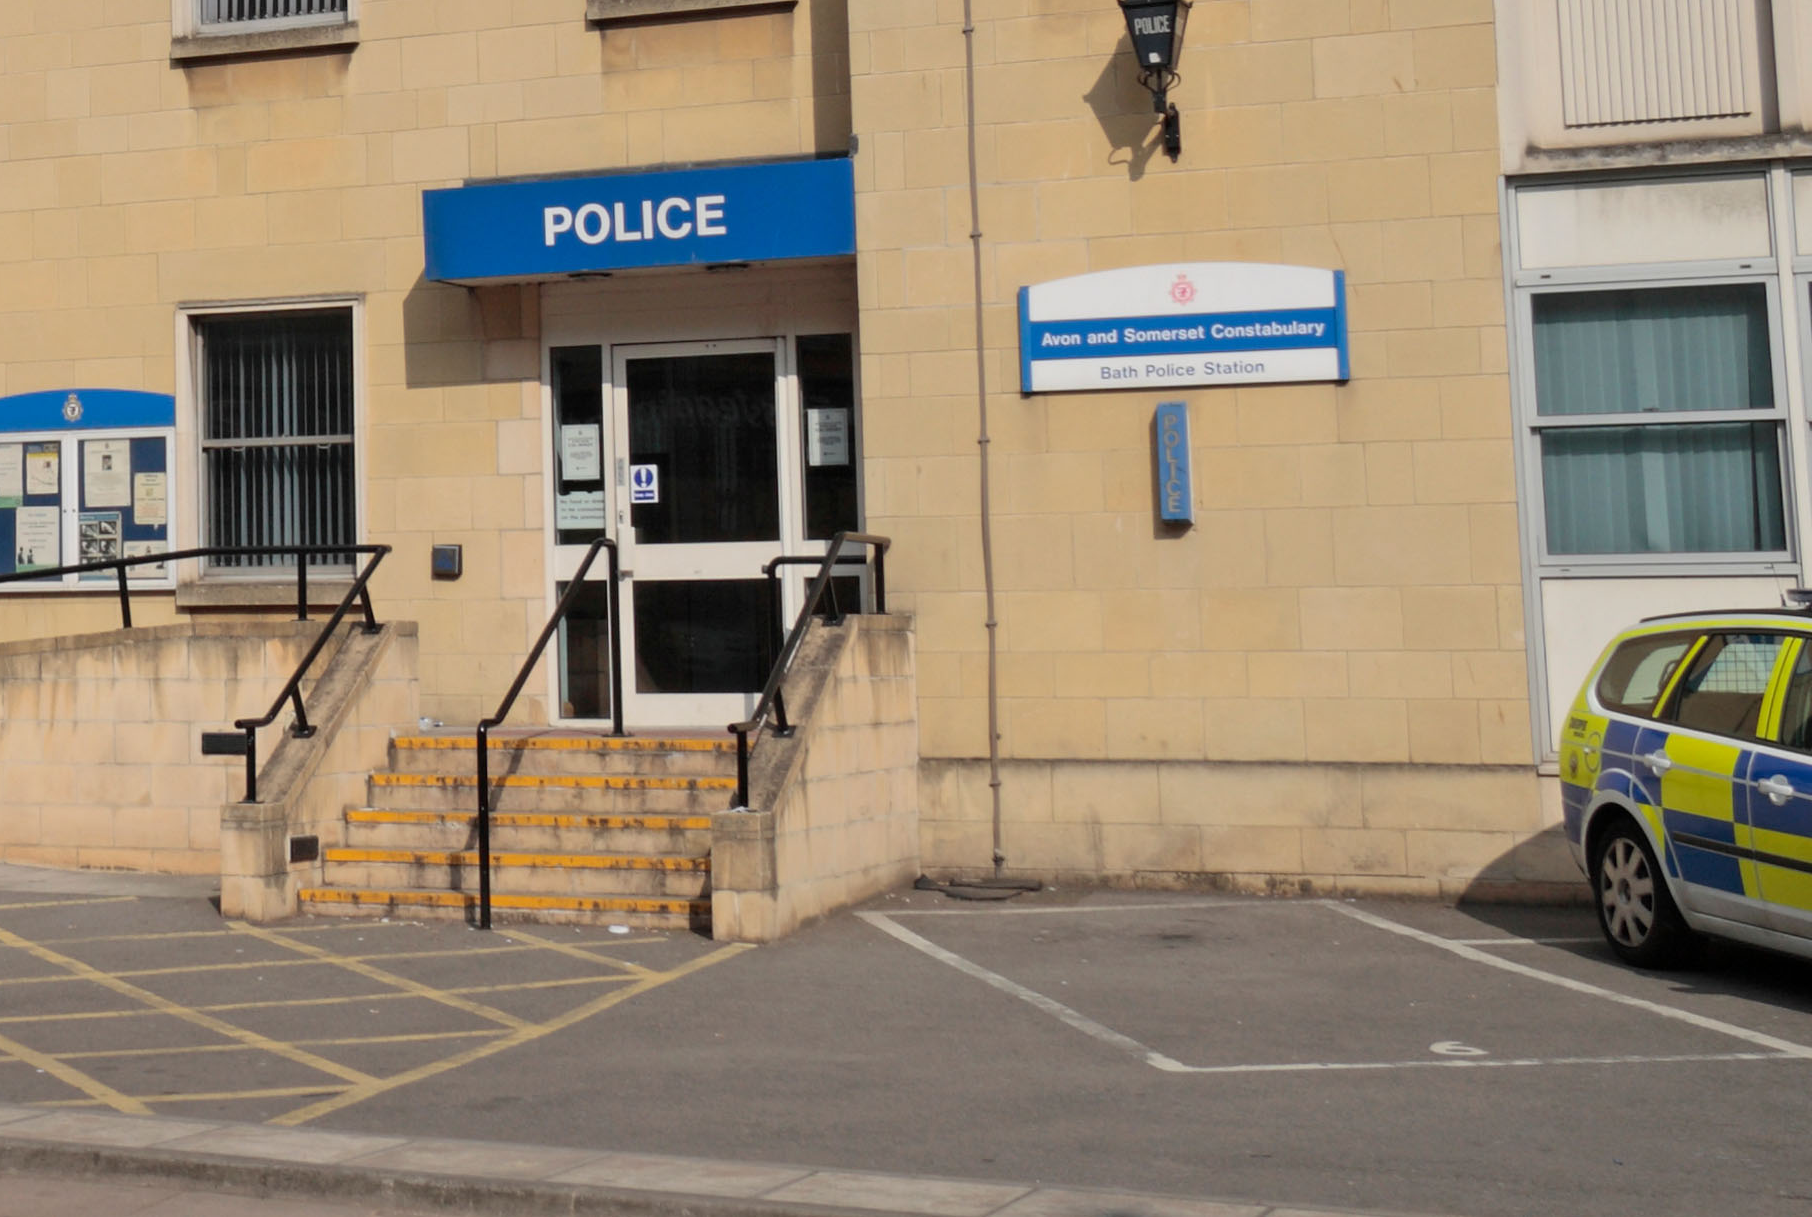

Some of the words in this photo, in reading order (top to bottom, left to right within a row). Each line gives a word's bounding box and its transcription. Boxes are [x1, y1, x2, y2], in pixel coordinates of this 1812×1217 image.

[1134, 15, 1171, 35] POLICE
[544, 195, 727, 246] POLICE
[1041, 332, 1081, 346] Avon
[1087, 329, 1118, 344] and
[1123, 325, 1205, 343] Somerset
[1211, 321, 1324, 337] Constabulary
[1100, 366, 1138, 379] Bath
[1145, 362, 1195, 377] Police
[1204, 361, 1265, 375] Station
[1164, 414, 1181, 513] POLICE
